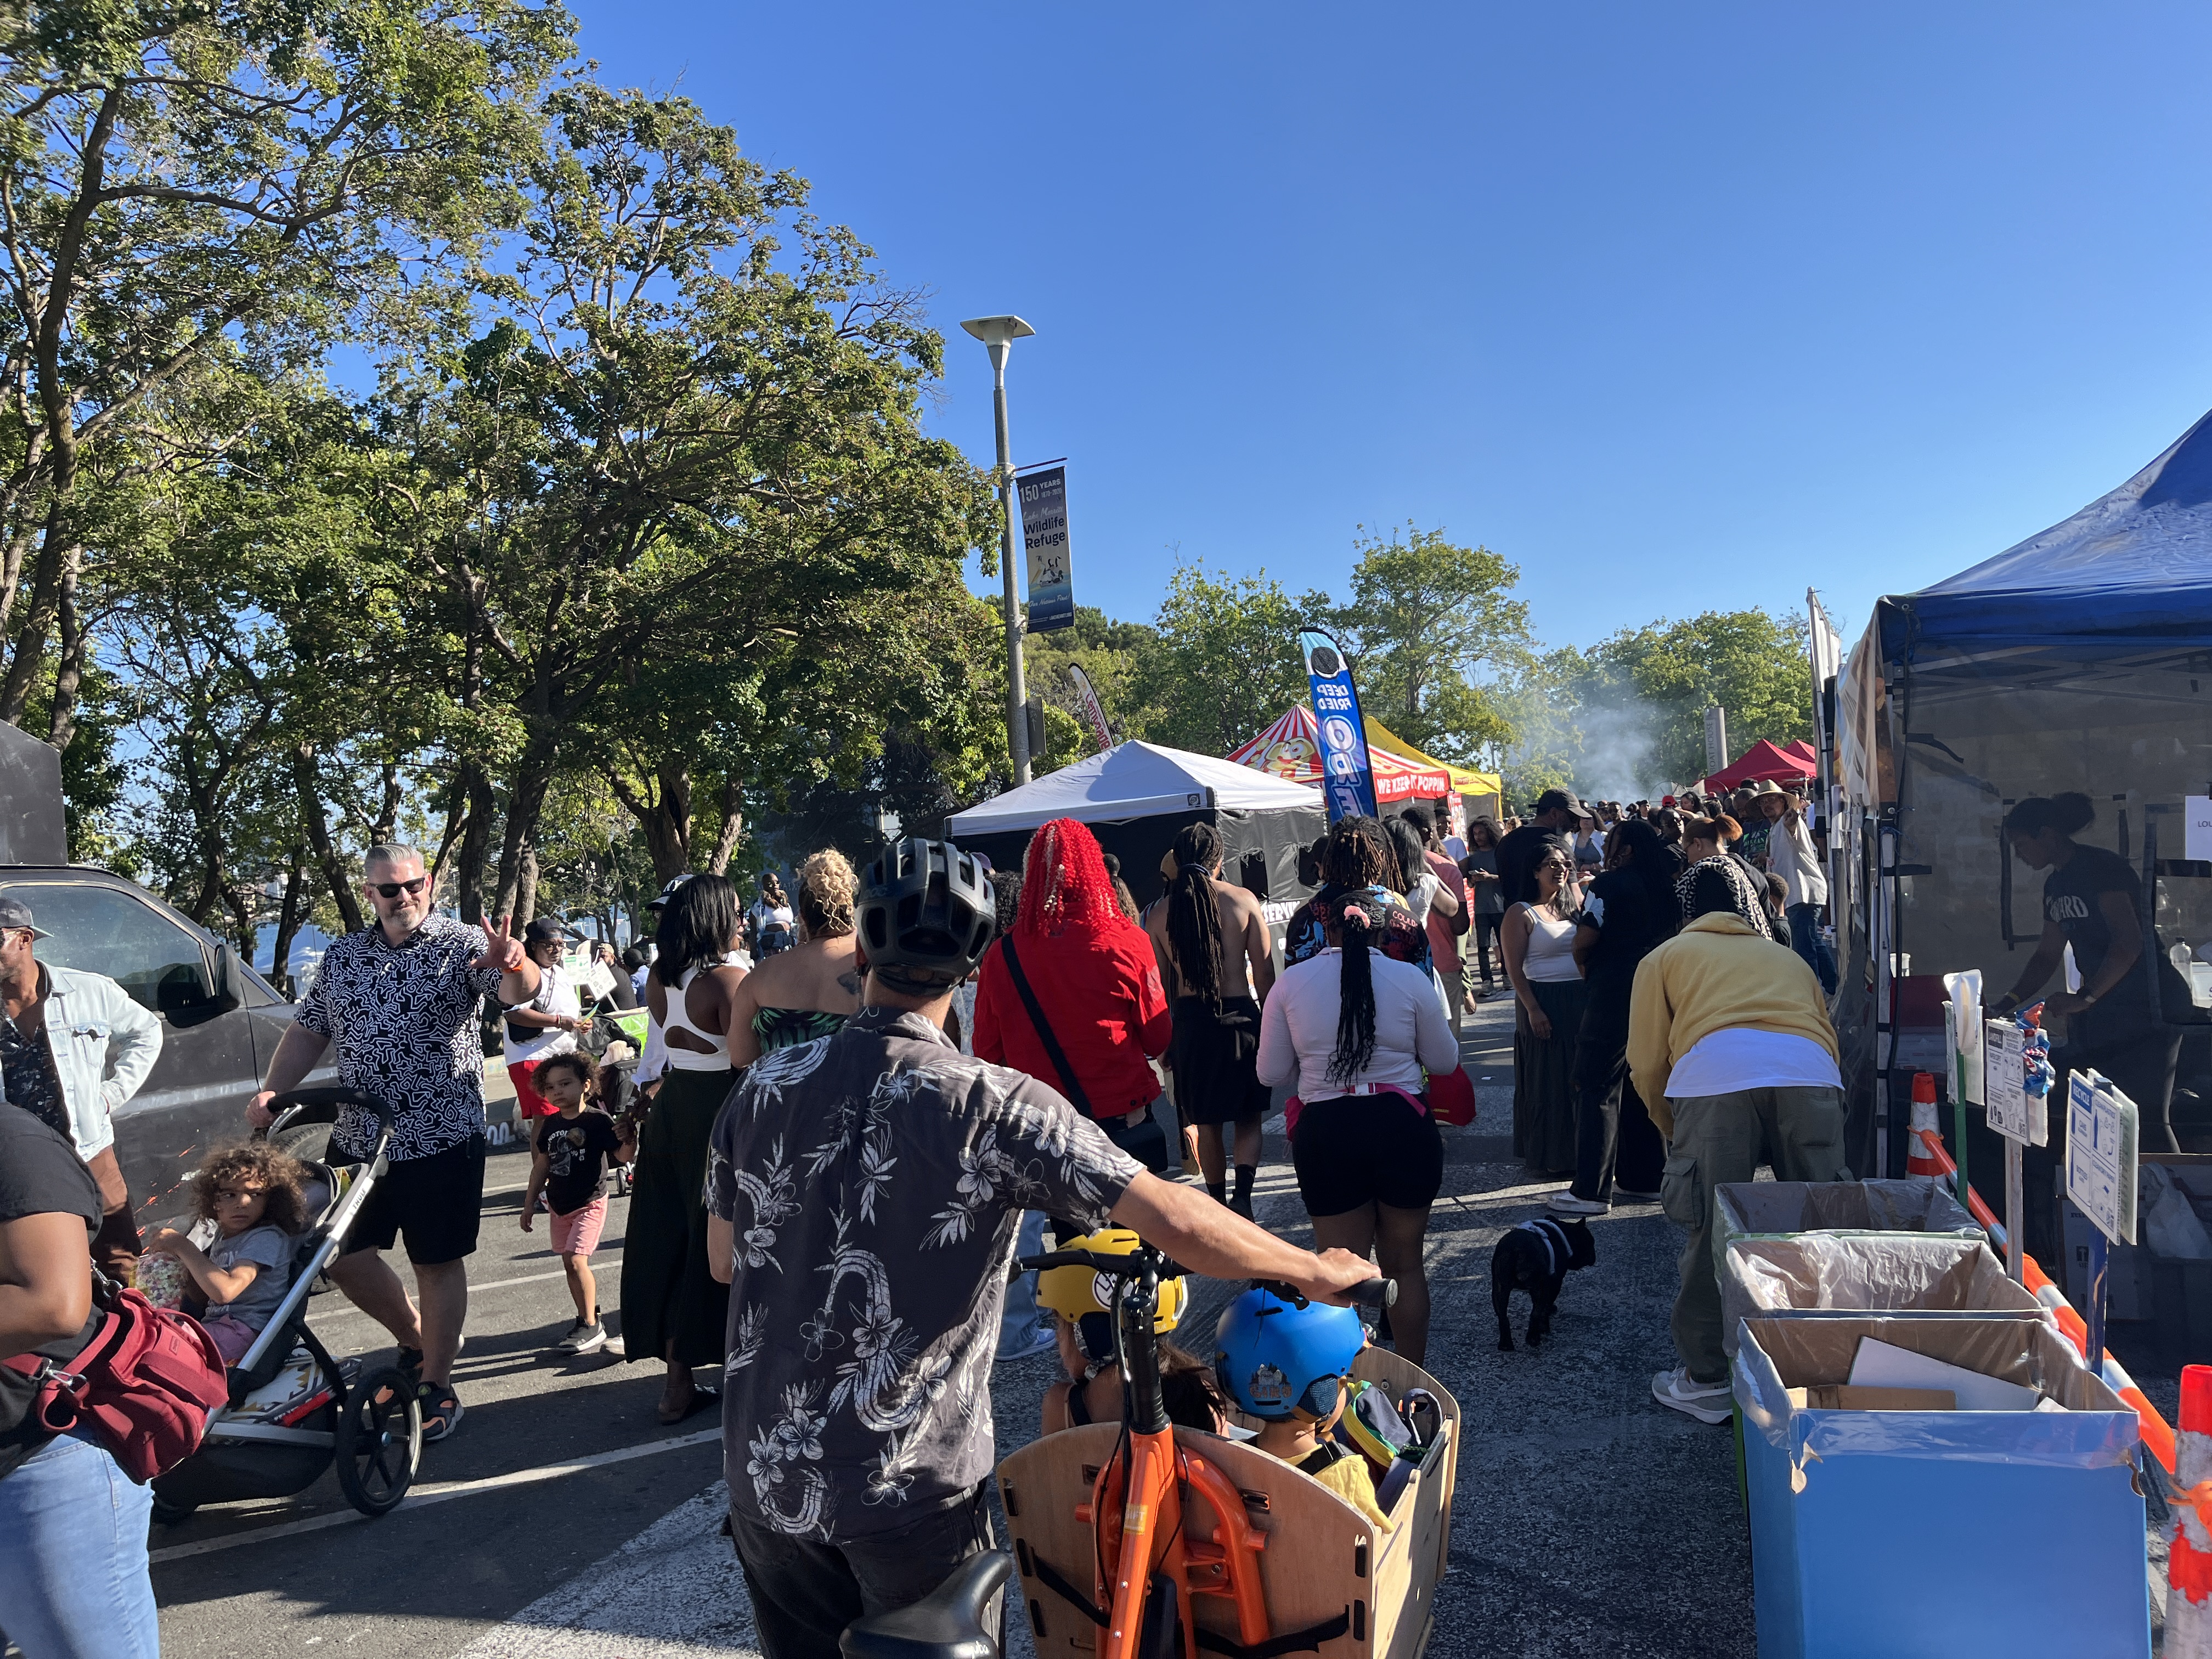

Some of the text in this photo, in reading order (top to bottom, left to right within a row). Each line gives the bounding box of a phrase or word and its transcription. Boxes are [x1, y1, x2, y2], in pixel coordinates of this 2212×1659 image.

[1040, 478, 1061, 489] YEARS
[1019, 484, 1039, 503] 150
[1023, 506, 1063, 521] Lake Merritt
[1023, 516, 1065, 535] Wildlife
[1025, 532, 1065, 549] Refuge
[1706, 721, 1714, 749] HOUSE
[1376, 777, 1391, 794] WE
[1391, 775, 1410, 794] KEEP
[2073, 1084, 2090, 1106] RECYCLE
